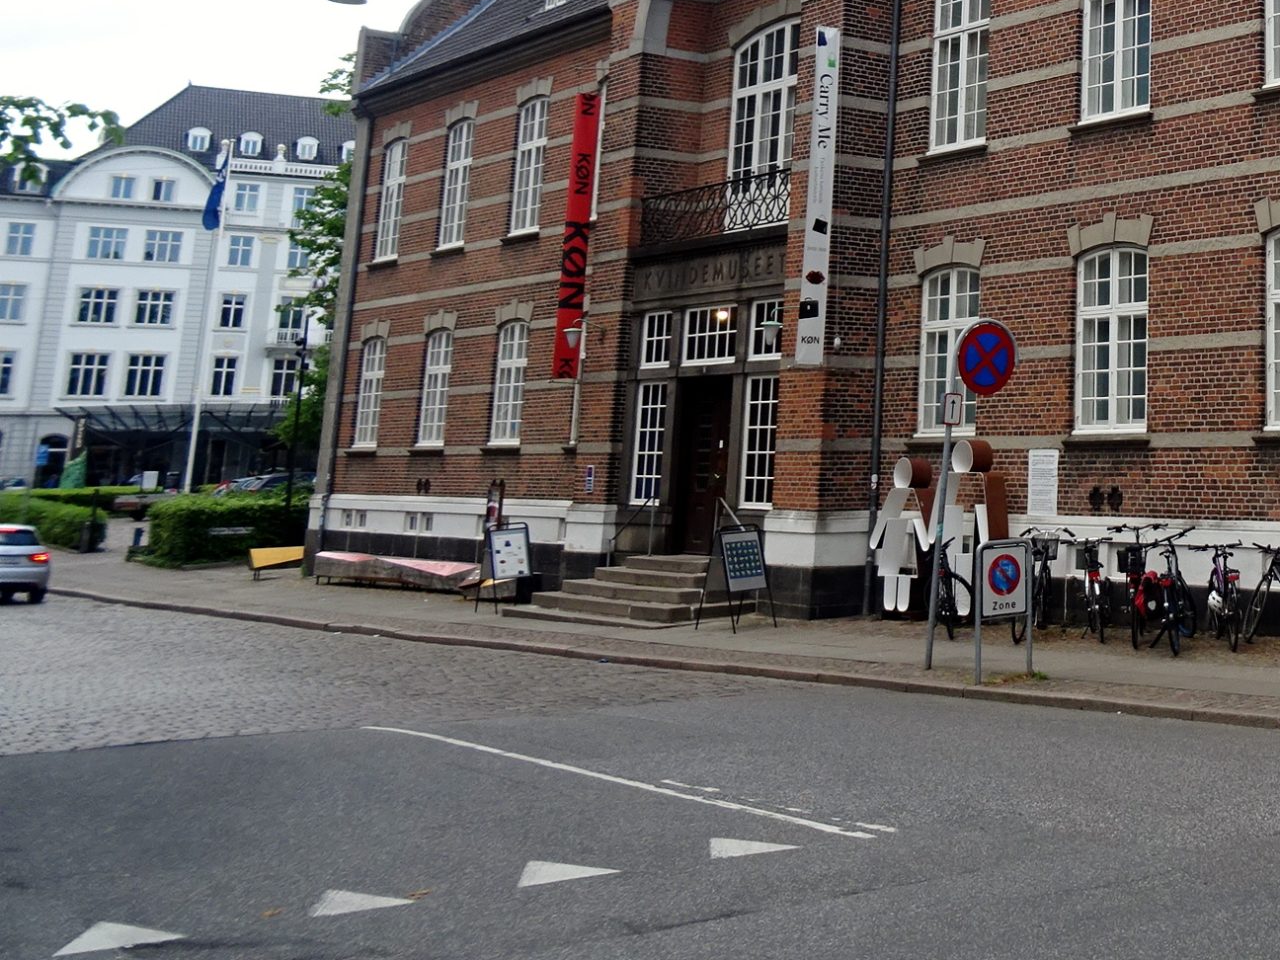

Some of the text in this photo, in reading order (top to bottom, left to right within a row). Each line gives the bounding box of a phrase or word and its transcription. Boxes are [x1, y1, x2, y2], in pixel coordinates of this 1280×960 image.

[816, 73, 834, 118] Carry
[817, 124, 832, 149] Me
[574, 153, 591, 195] KØN
[558, 221, 590, 310] KØN
[801, 336, 820, 345] KØN
[992, 601, 1016, 611] Zone
